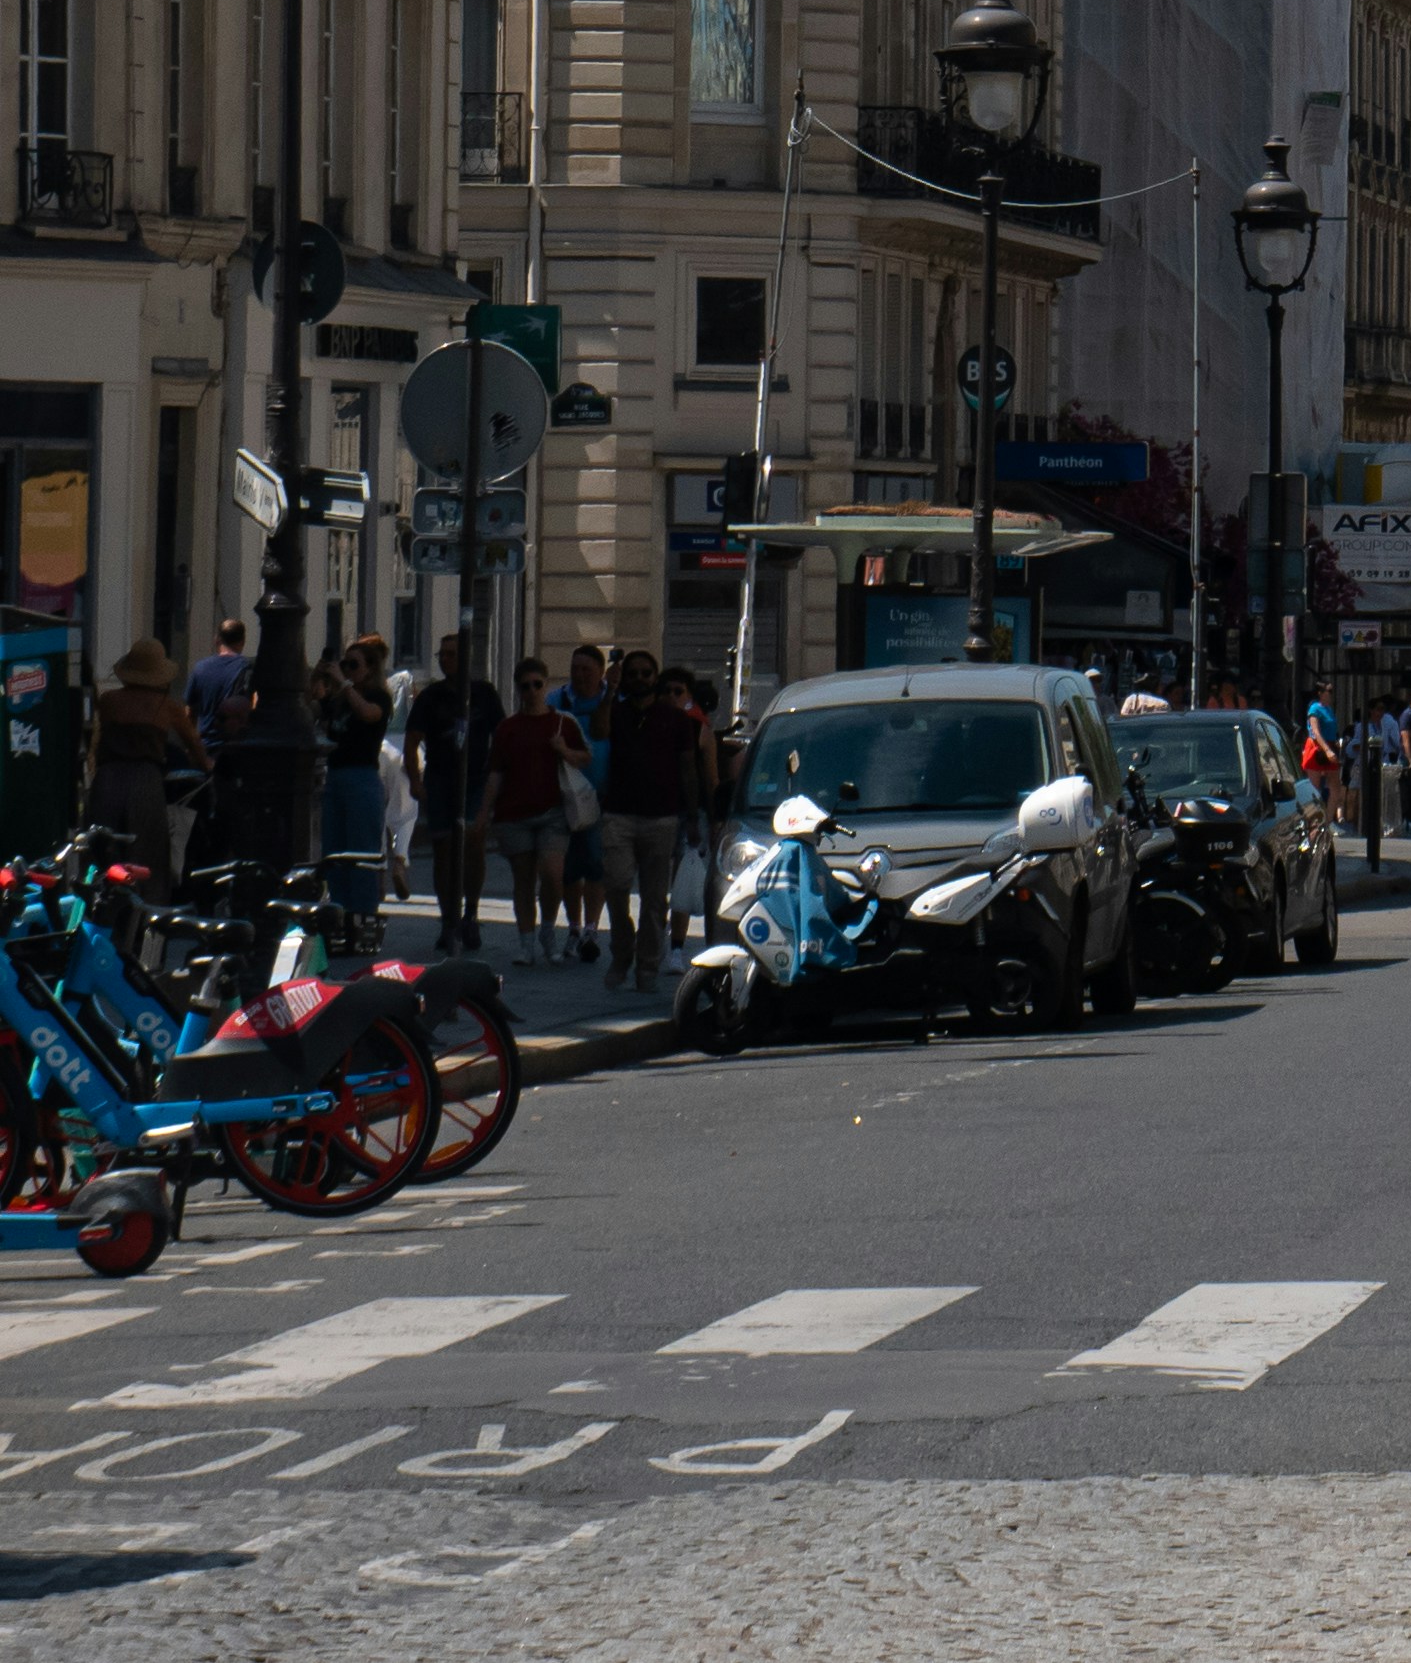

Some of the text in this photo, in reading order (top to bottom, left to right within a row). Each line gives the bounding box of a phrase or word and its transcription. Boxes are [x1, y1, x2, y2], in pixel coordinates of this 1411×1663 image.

[331, 326, 361, 357] BNP
[967, 360, 1008, 382] BS
[1038, 455, 1104, 469] Panthéon
[1207, 840, 1234, 852] 1106
[265, 980, 324, 1030] GRATUIT
[29, 1025, 94, 1095] dott
